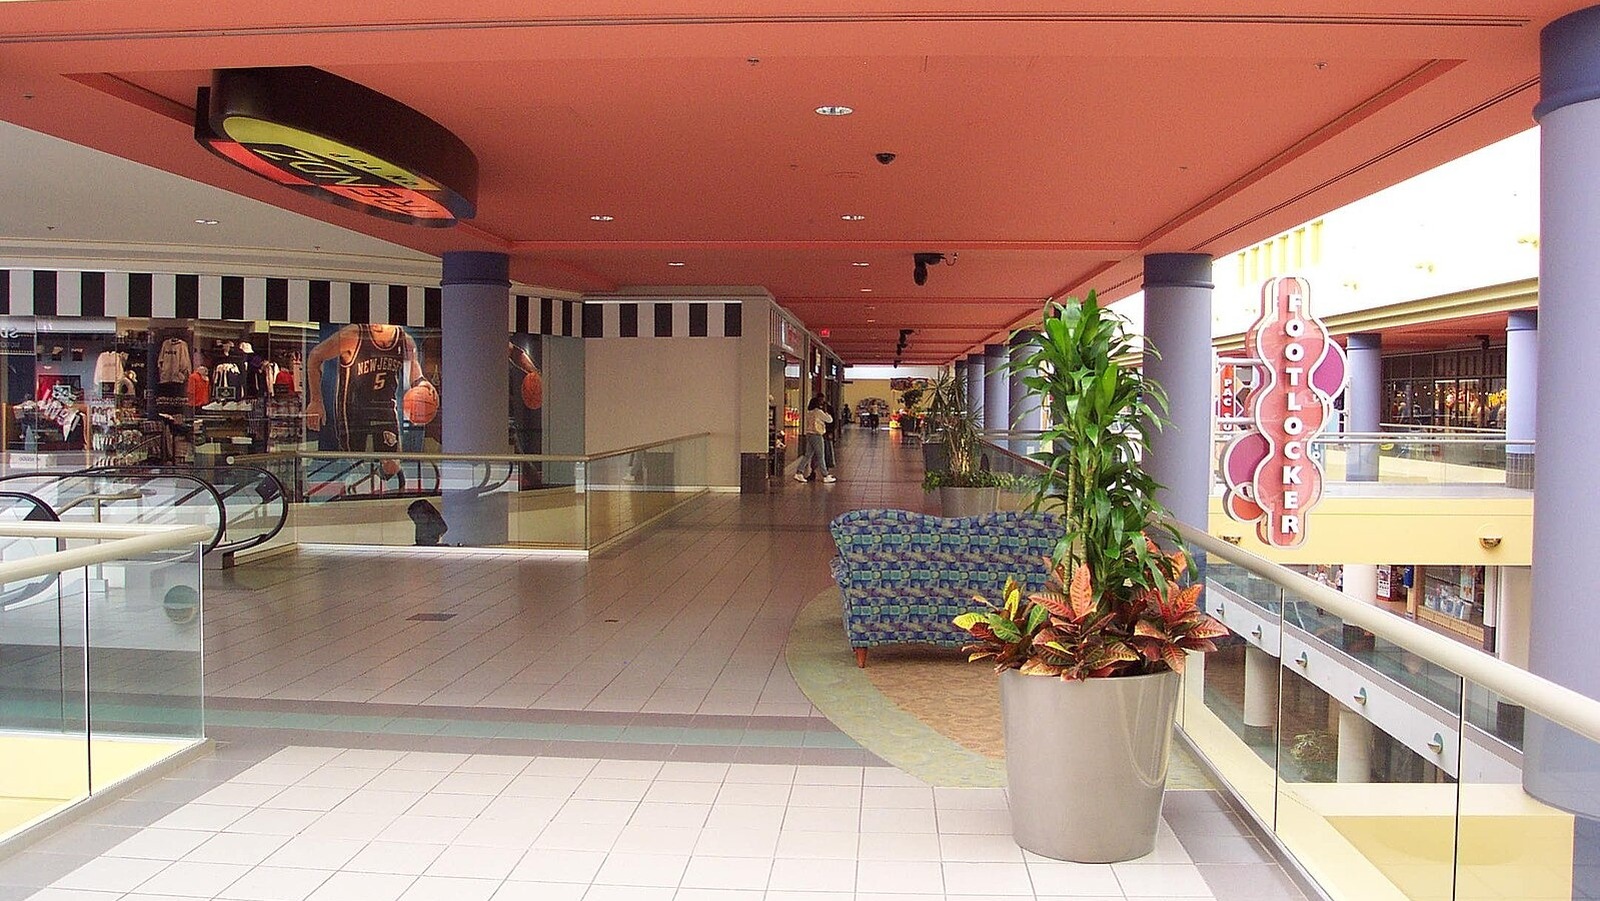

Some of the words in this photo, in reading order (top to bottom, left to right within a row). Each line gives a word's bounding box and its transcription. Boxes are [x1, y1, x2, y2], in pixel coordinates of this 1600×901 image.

[253, 148, 438, 214] TRENDZ
[357, 357, 378, 375] NEW
[374, 372, 387, 390] 5
[1222, 378, 1233, 407] PAC
